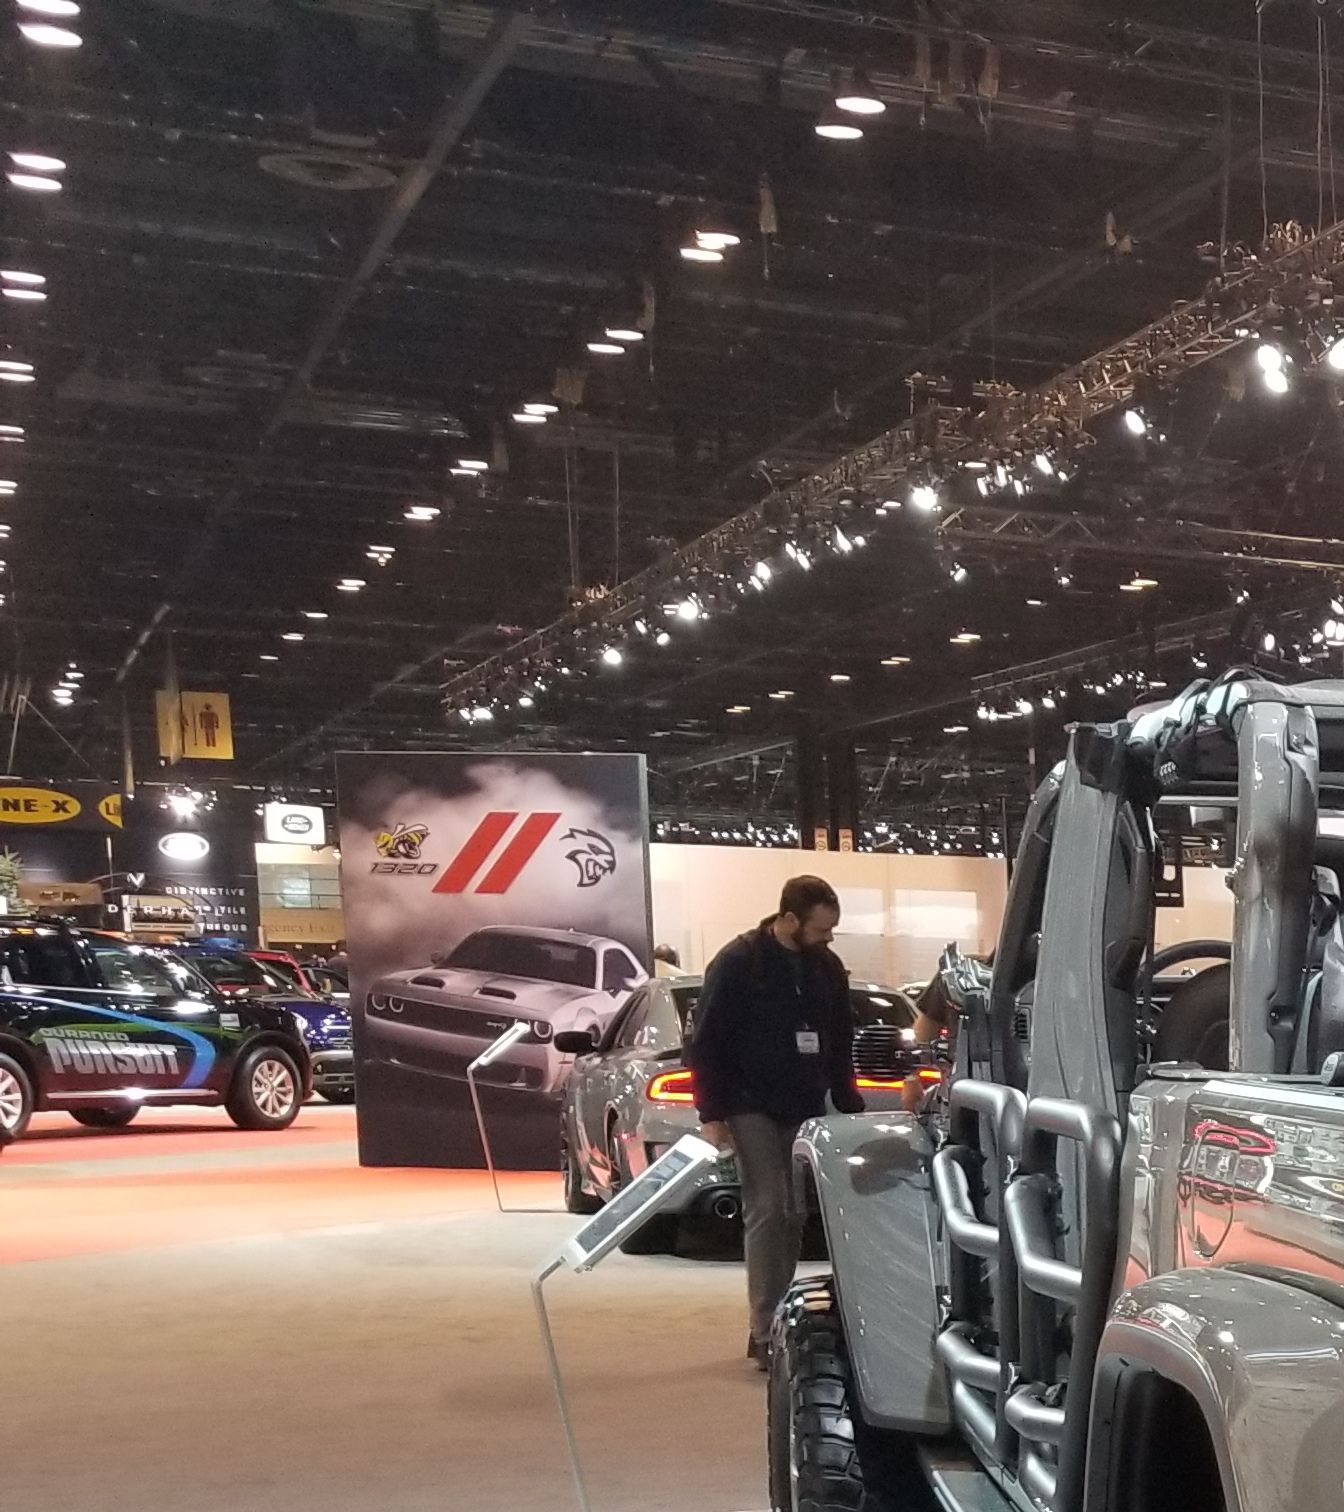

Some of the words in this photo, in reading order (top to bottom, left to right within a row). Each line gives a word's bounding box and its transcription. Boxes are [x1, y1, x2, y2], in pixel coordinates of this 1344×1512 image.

[370, 862, 439, 875] 1320
[39, 1027, 130, 1042] DURANGO
[44, 1037, 180, 1075] PURSUIT
